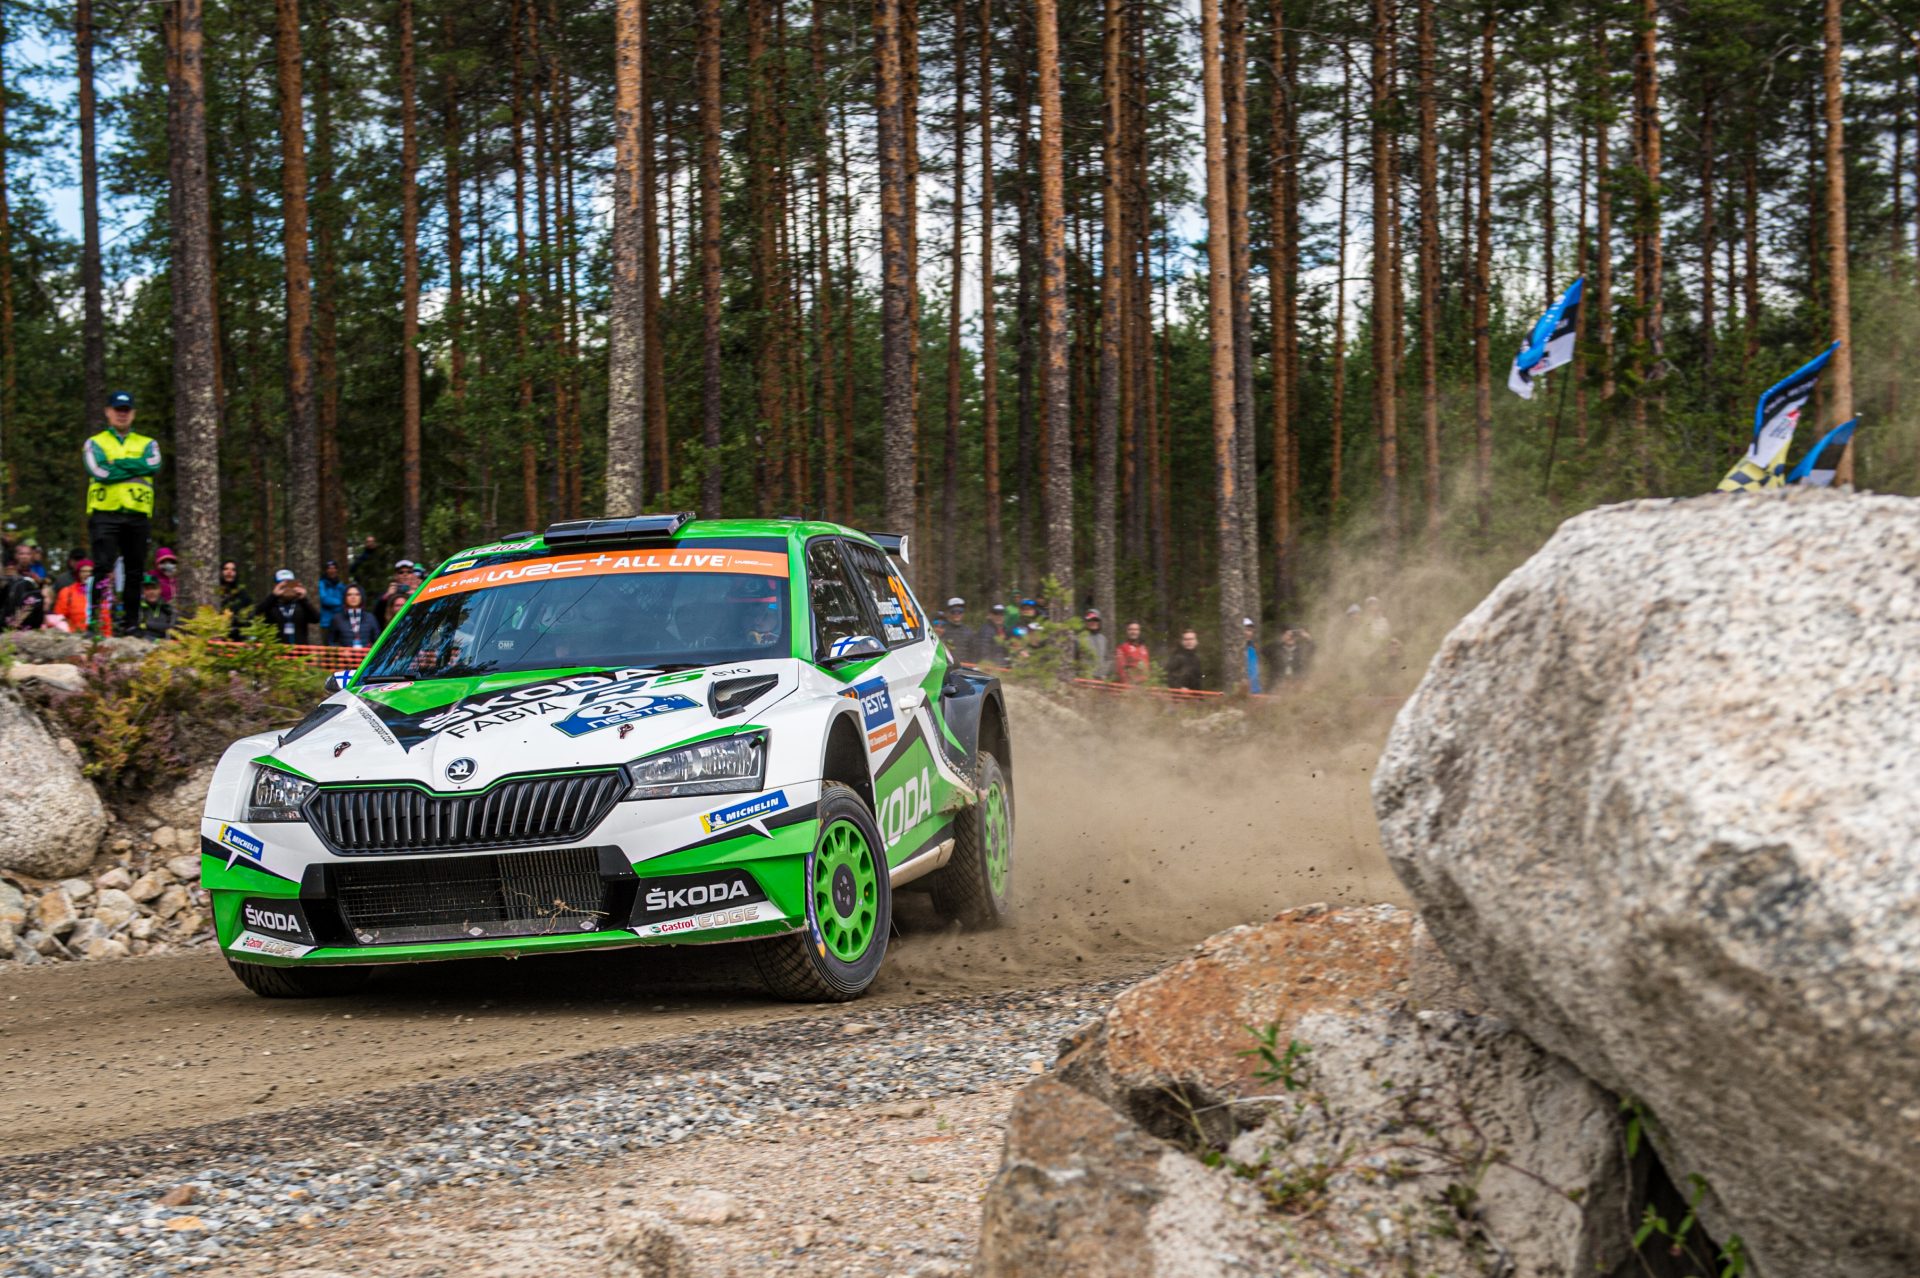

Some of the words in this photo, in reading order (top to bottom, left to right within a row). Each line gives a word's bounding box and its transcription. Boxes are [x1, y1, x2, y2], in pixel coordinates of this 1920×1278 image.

[428, 583, 448, 593] WRC
[460, 576, 479, 586] PRO
[613, 555, 661, 569] ALL
[669, 554, 726, 568] LIVE
[446, 701, 568, 739] FABIA
[712, 667, 751, 677] evo
[587, 704, 670, 728] NESTE
[593, 701, 636, 715] 21
[861, 689, 889, 717] NESTE
[725, 797, 779, 822] MICHELIN
[876, 766, 932, 852] KODA
[231, 835, 260, 854] MICHELIN
[645, 880, 749, 911] ŠKODA
[245, 904, 301, 932] ŠKODA
[661, 919, 695, 932] Castrol
[698, 906, 760, 928] EDGE
